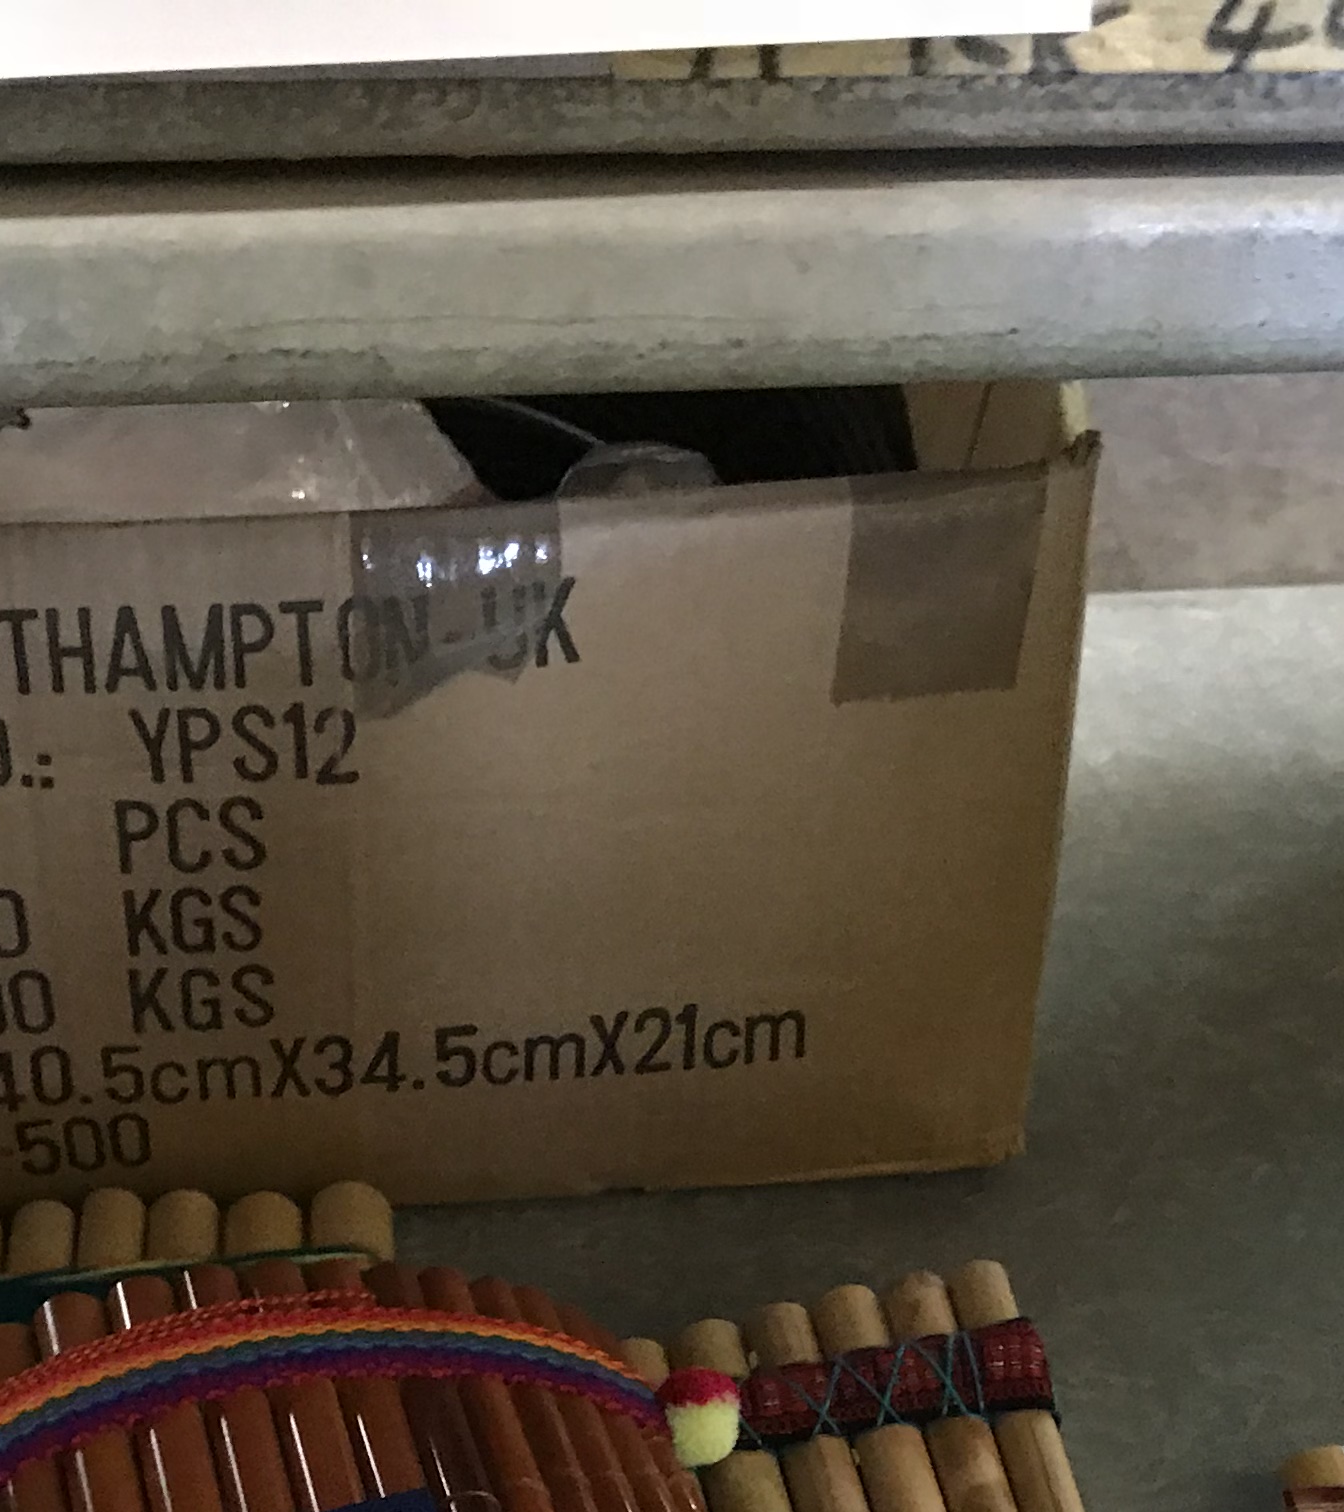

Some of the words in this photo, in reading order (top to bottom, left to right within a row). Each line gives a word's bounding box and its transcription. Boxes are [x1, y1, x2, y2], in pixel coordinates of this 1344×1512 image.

[128, 705, 360, 785] YPS12
[115, 797, 267, 874] PCS
[122, 885, 263, 956] KGS
[128, 964, 275, 1034] KGS
